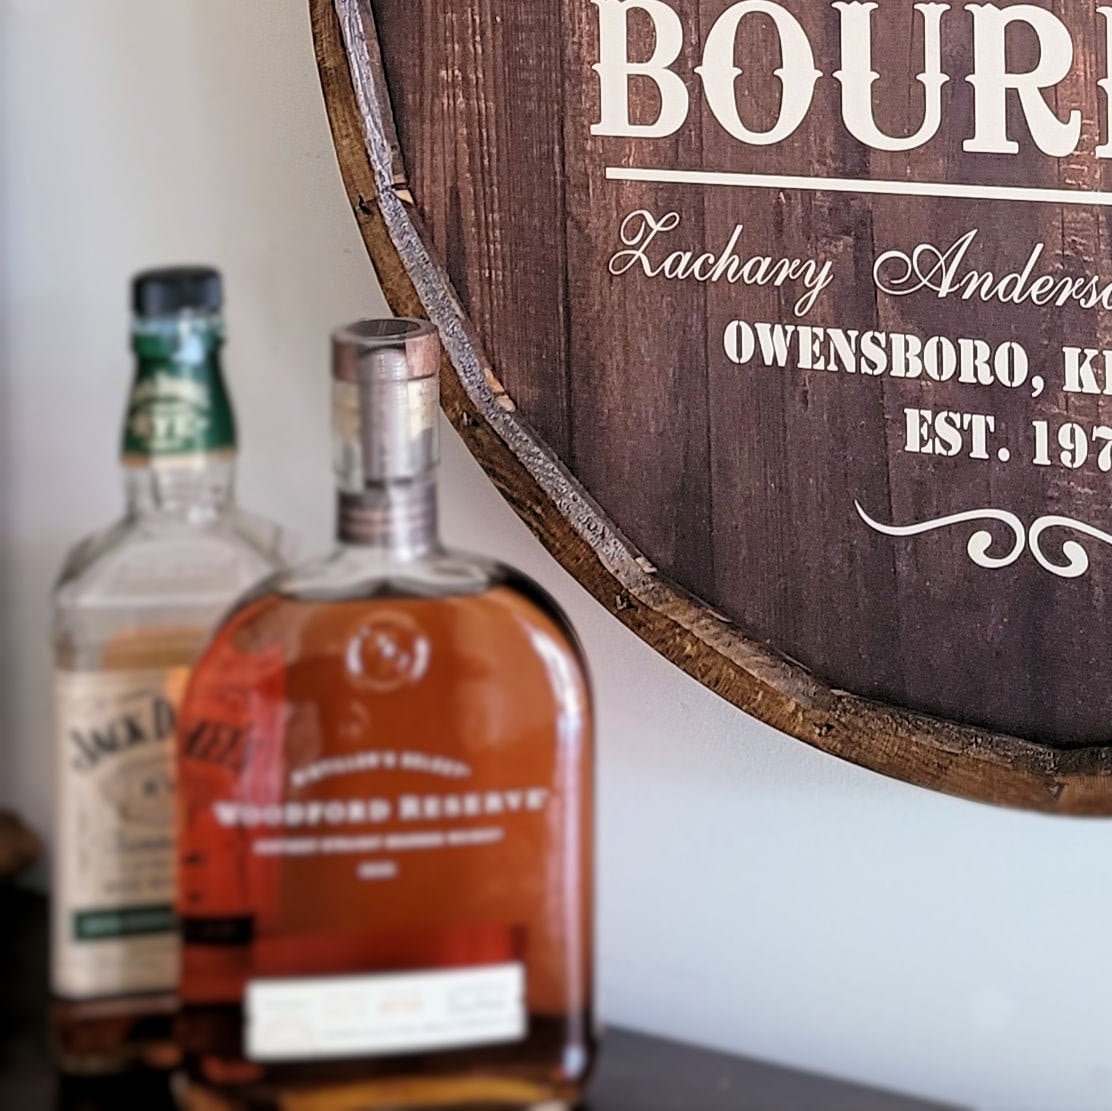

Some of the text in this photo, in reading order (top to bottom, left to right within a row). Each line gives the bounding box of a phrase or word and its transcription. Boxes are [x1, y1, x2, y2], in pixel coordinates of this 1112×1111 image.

[608, 210, 834, 316] Zachary
[724, 320, 1045, 398] OWENSBORO,
[904, 408, 1010, 462] EST.
[213, 789, 543, 828] WOODFORD RESERVE
